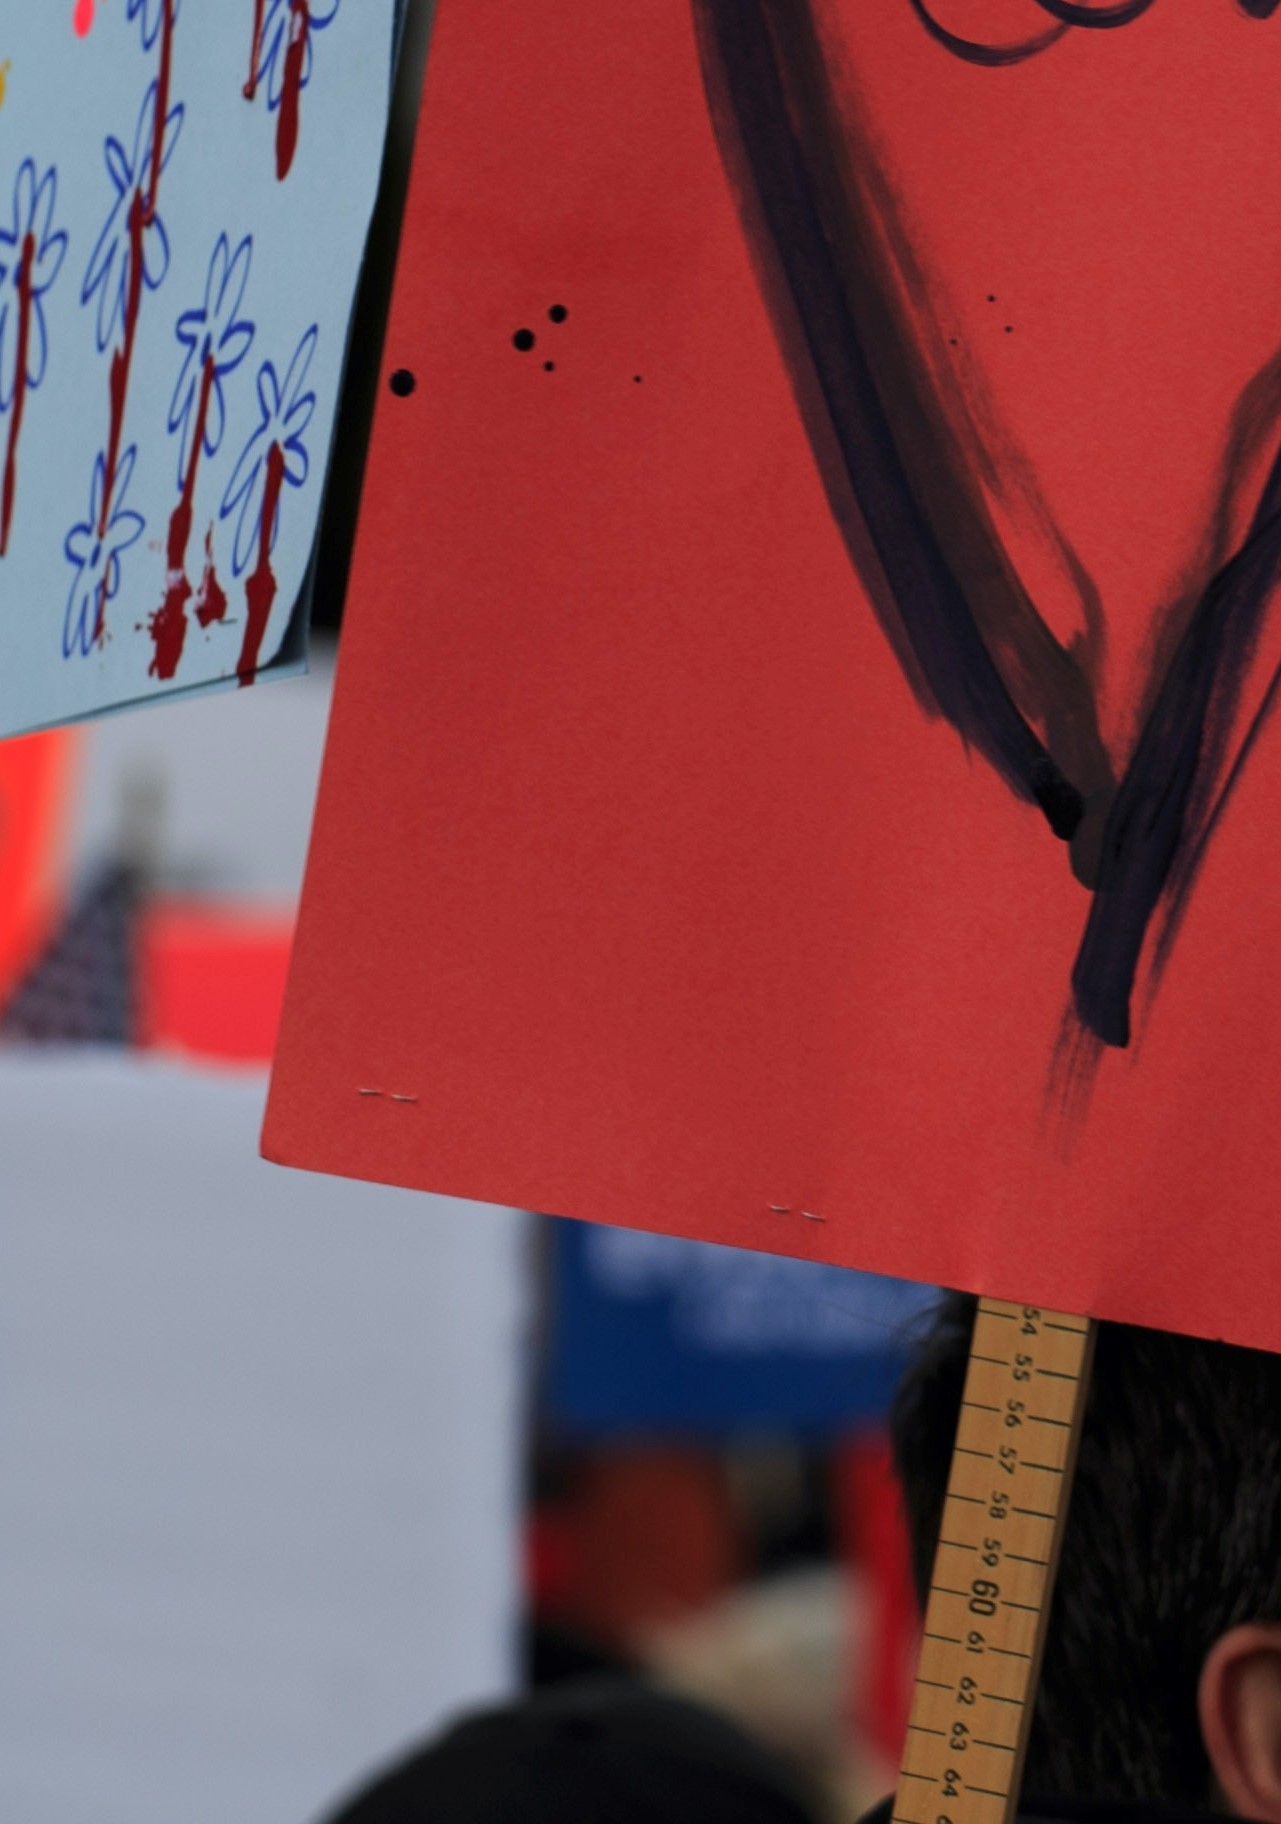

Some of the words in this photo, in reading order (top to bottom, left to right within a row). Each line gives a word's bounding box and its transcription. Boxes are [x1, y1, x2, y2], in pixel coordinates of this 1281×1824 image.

[1021, 1305, 1041, 1336] 54
[1012, 1352, 1033, 1382] 55
[1004, 1398, 1025, 1428] 56
[997, 1445, 1017, 1475] 57
[989, 1490, 1010, 1520] 58
[981, 1537, 1002, 1567] 59
[968, 1579, 1000, 1617] 60
[965, 1631, 986, 1655] 61
[956, 1676, 978, 1706] 62
[949, 1722, 970, 1752] 63
[941, 1769, 961, 1799] 64
